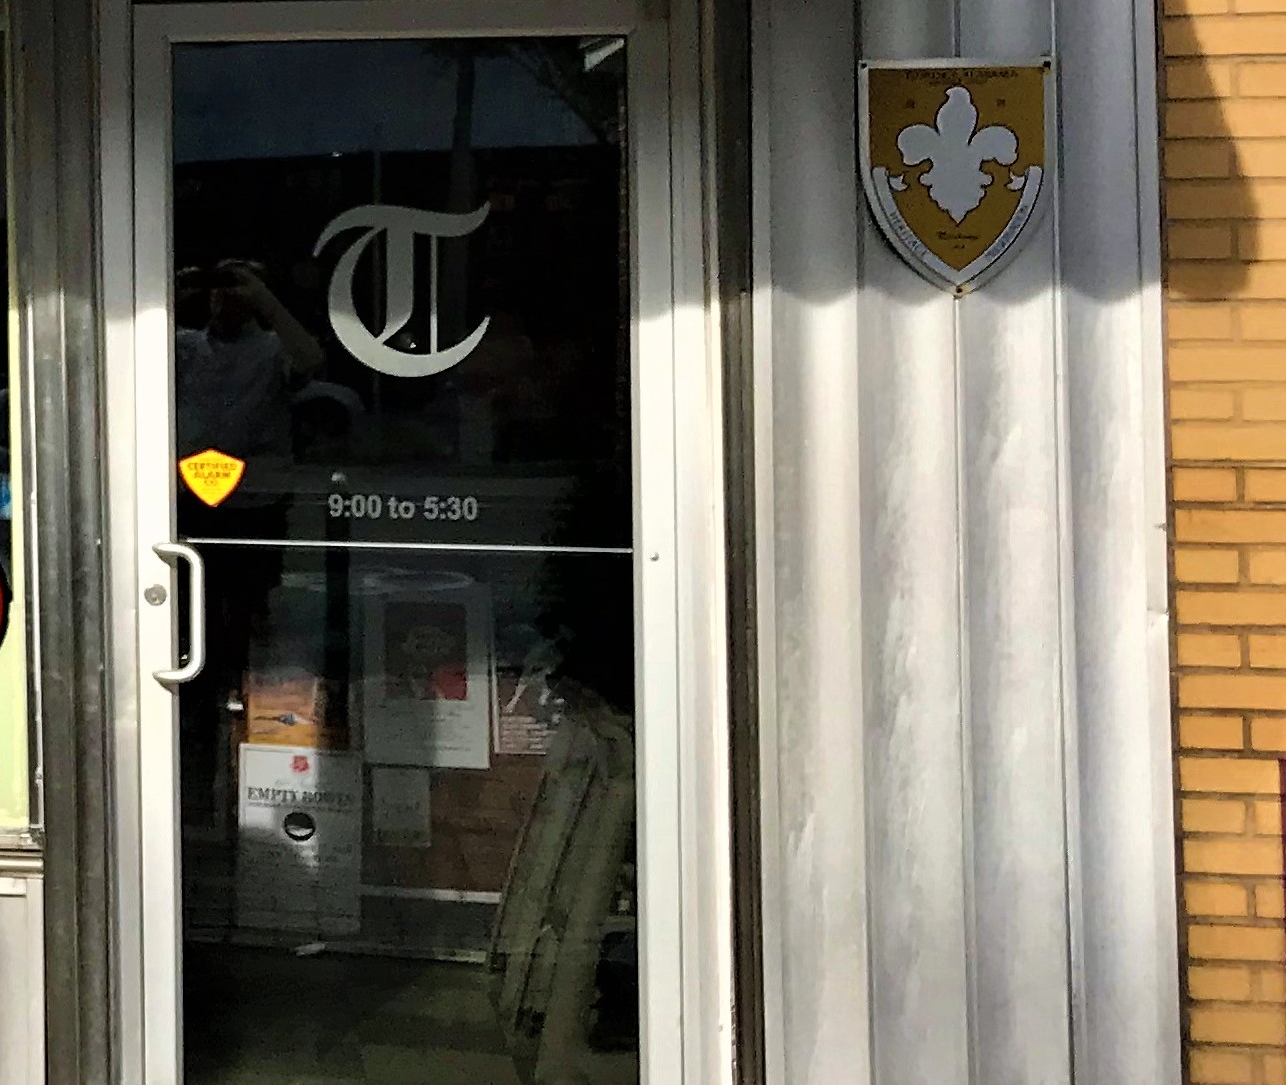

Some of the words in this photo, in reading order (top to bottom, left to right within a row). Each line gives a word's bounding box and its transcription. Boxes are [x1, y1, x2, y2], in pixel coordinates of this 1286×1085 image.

[327, 493, 383, 519] 9:00
[387, 495, 416, 520] to
[422, 496, 480, 521] 5:30
[247, 787, 299, 803] EMPTY
